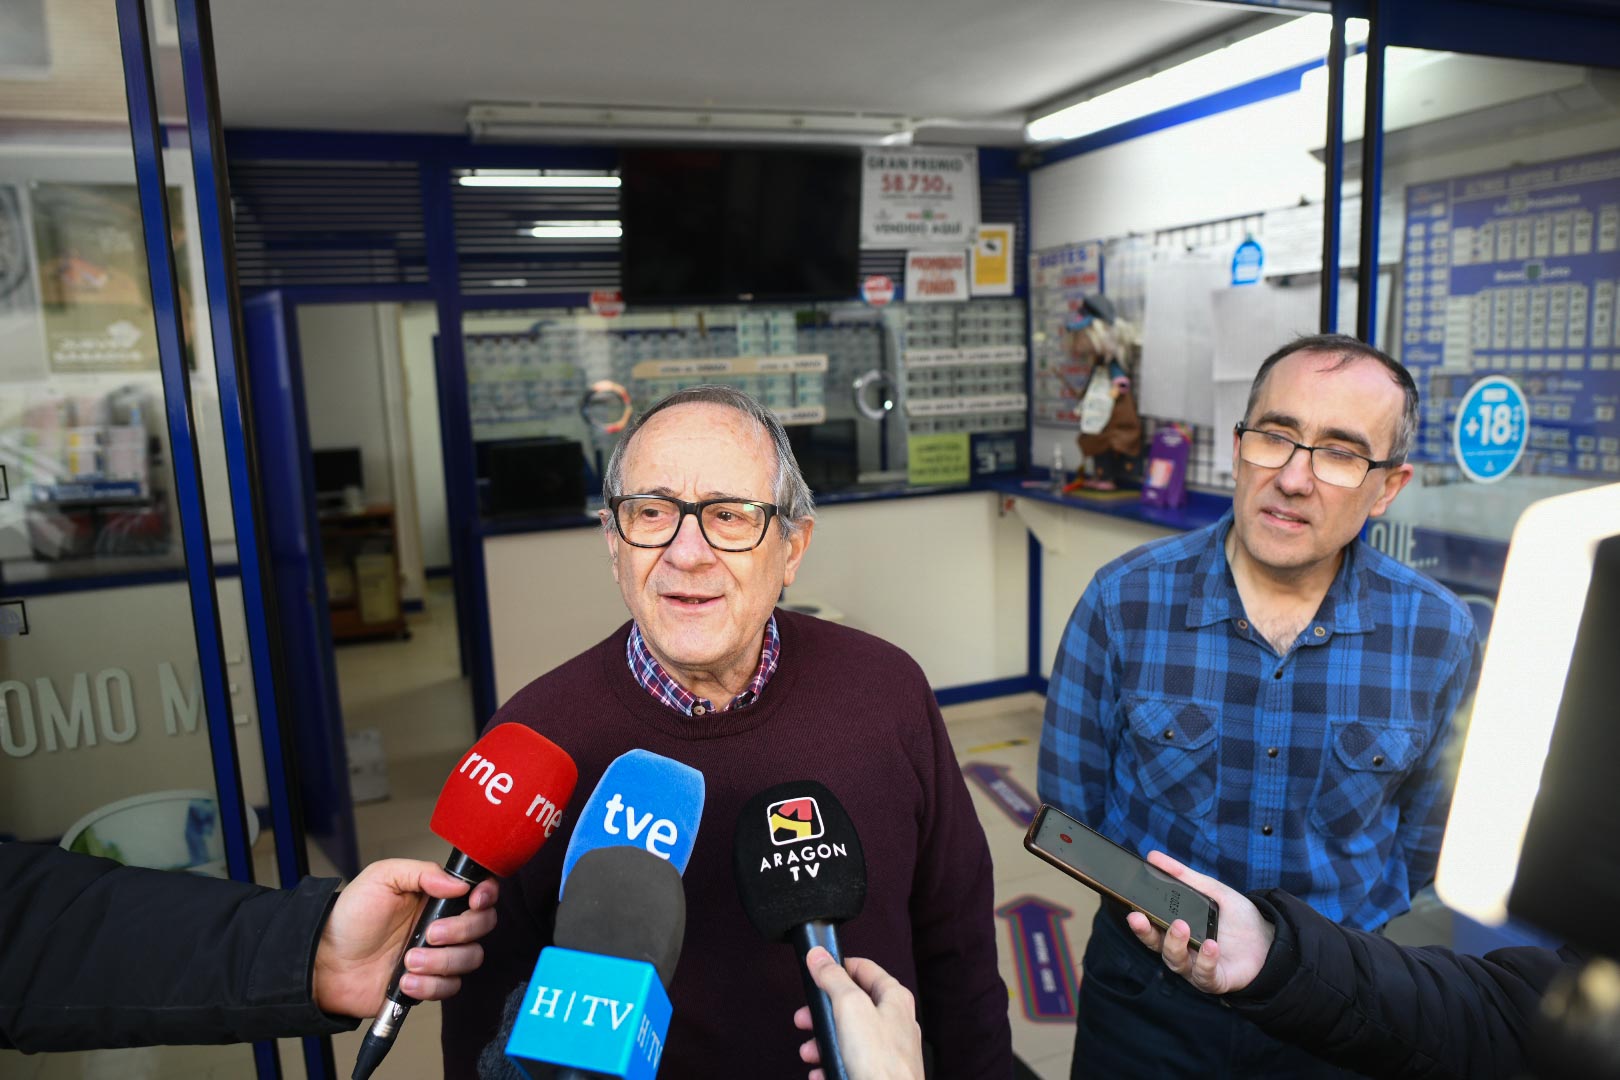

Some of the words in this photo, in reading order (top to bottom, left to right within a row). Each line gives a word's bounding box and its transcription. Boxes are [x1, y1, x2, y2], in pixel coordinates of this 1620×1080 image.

[1464, 403, 1512, 446] +18
[459, 752, 514, 805] rne
[525, 793, 563, 838] rne
[603, 793, 679, 861] tve
[760, 843, 847, 873] ARAGON
[789, 862, 820, 882] TV
